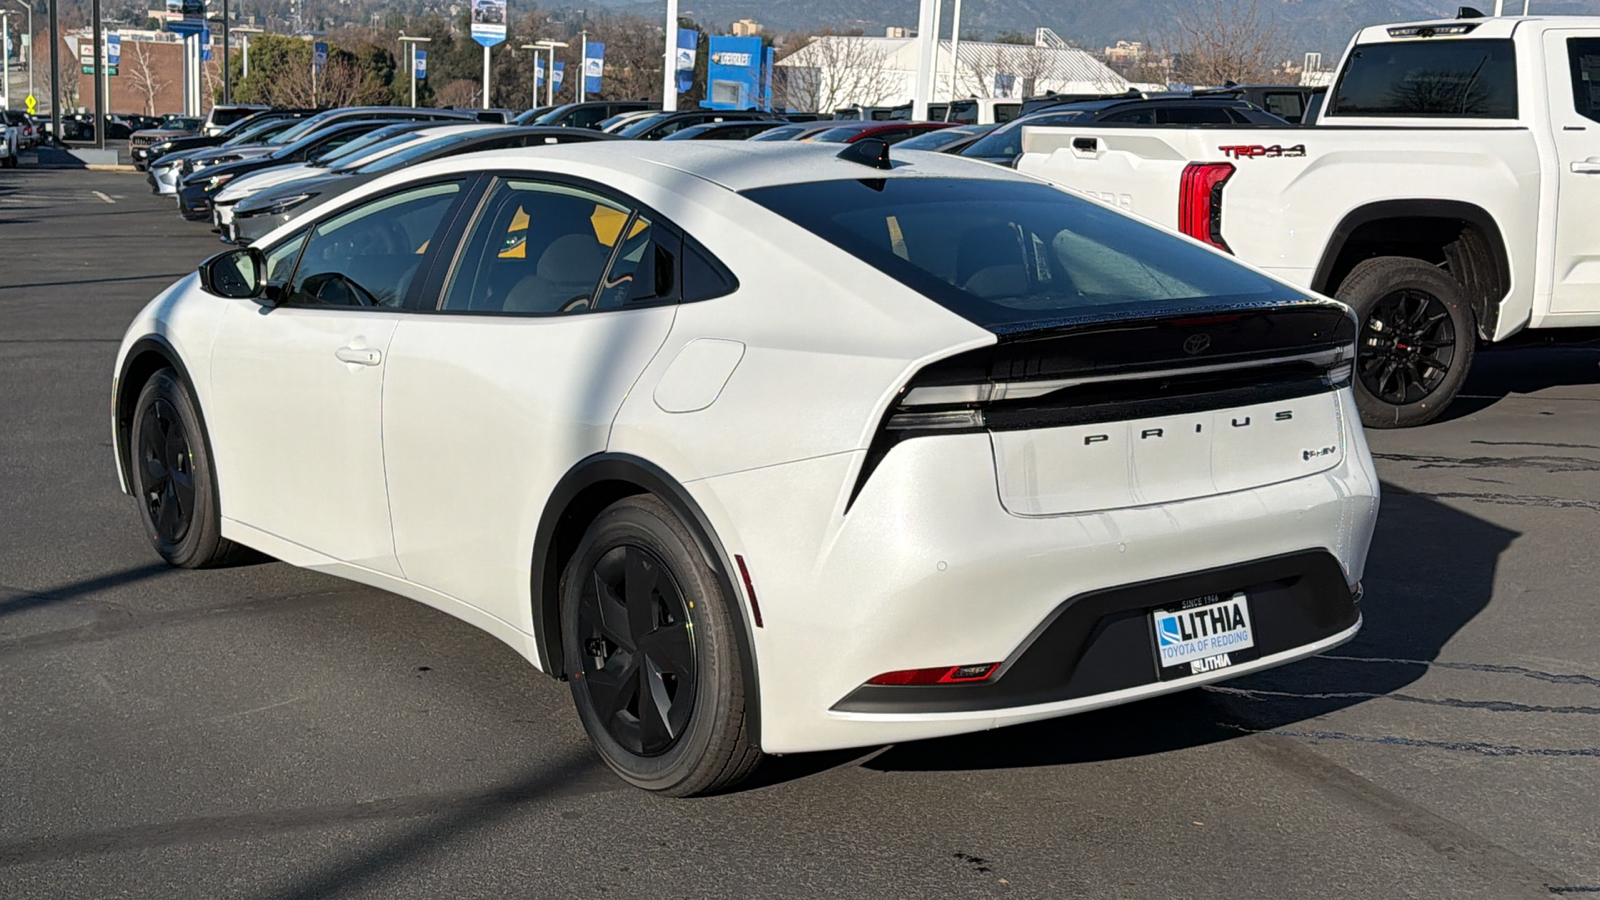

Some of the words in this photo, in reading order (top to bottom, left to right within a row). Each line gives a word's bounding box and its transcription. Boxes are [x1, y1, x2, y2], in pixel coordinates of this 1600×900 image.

[1218, 144, 1266, 160] TRD
[1084, 410, 1293, 445] PRIUS
[1182, 596, 1202, 609] SINCE
[1204, 594, 1219, 605] 1946
[1177, 603, 1246, 642] LITHIA
[1162, 643, 1197, 660] TOYOTA
[1197, 639, 1209, 652] OF
[1211, 630, 1248, 649] REDDING
[1199, 653, 1232, 671] LITHIA
